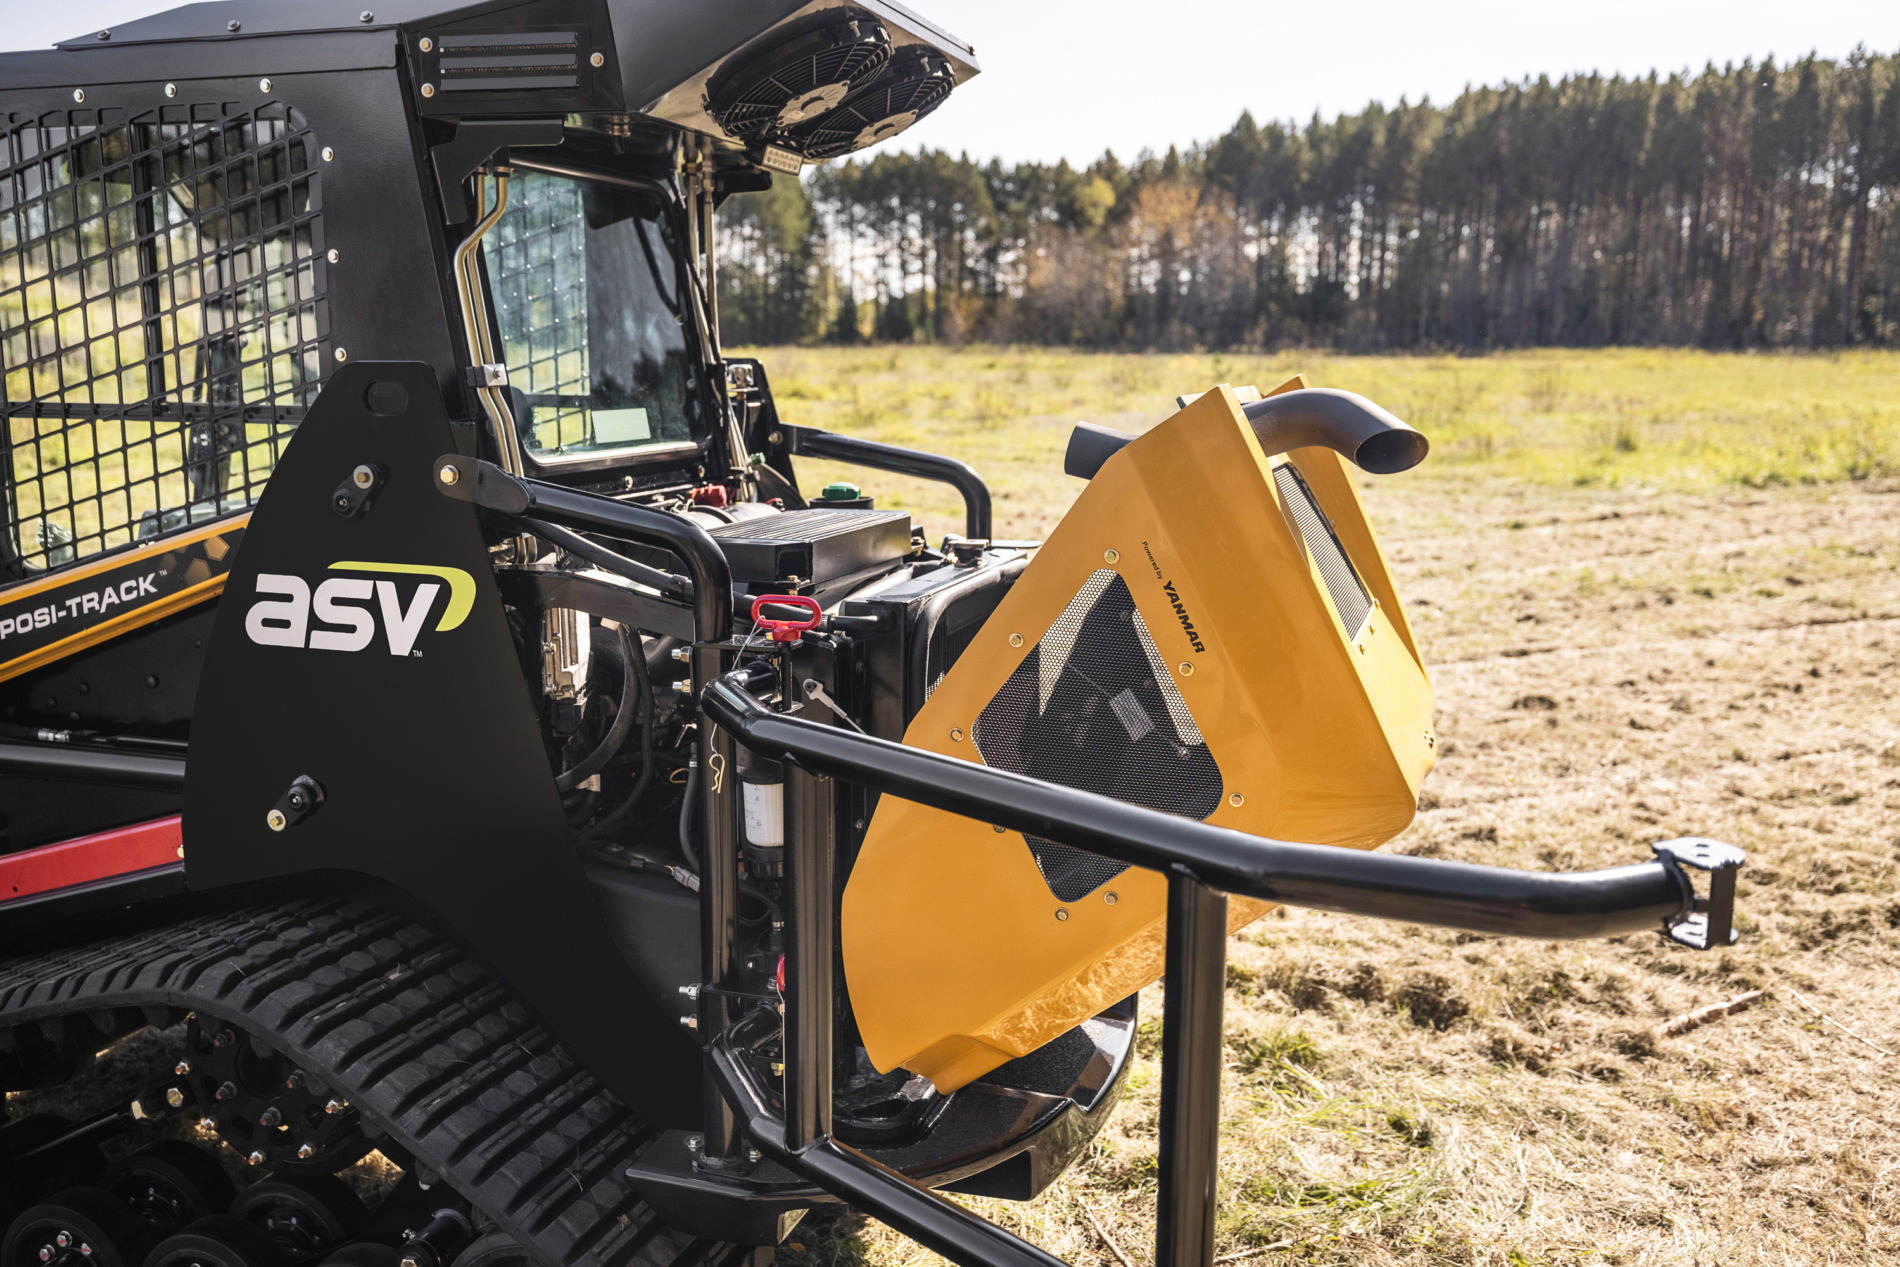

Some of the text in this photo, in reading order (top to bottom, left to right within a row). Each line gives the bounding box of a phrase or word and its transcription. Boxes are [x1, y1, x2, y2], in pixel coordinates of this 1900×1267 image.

[0, 572, 158, 640] POSI-TRACK
[1142, 541, 1205, 653] Powered by YANMAR
